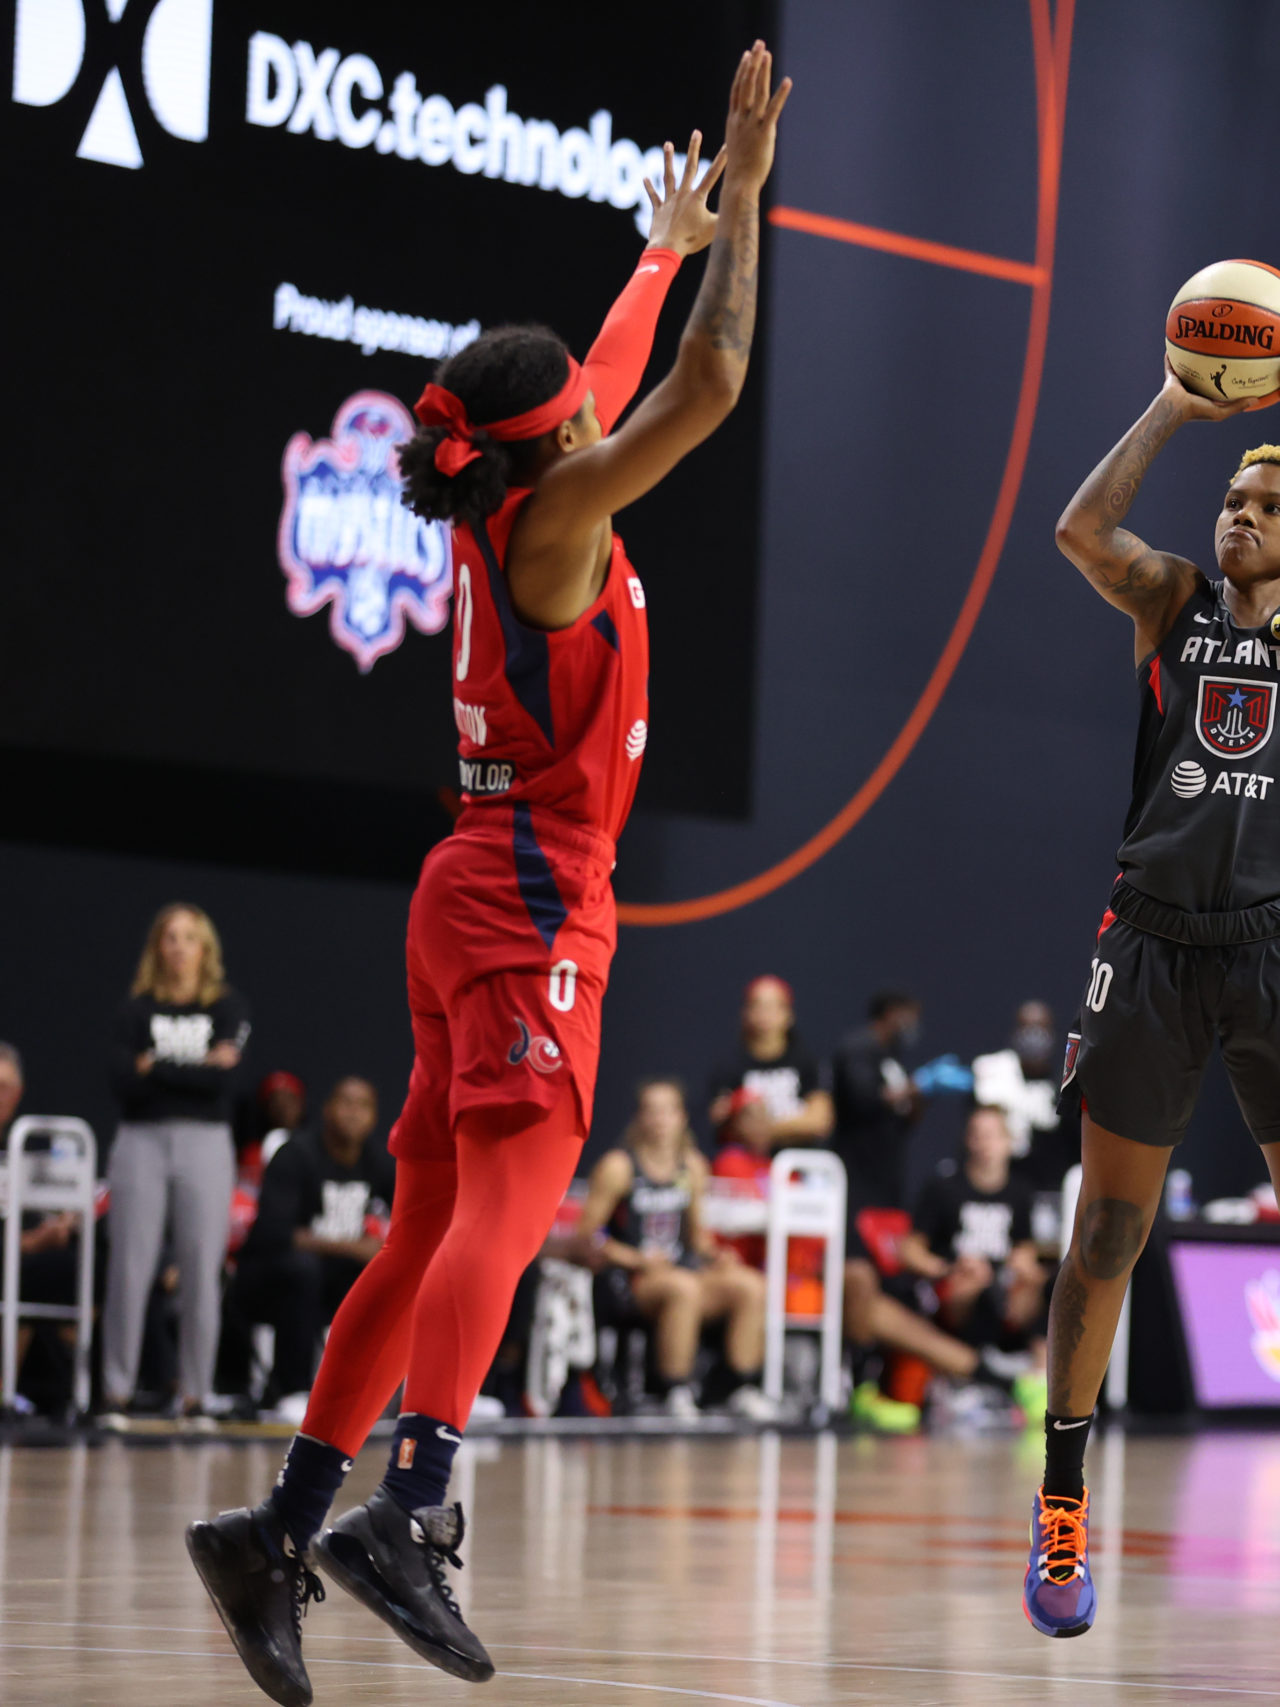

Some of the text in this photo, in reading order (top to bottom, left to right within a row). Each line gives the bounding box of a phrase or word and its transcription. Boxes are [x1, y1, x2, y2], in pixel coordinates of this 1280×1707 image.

[245, 30, 717, 240] DXC.technolog
[1175, 314, 1275, 350] SPALDING
[1210, 727, 1256, 747] DREAM
[1211, 771, 1275, 800] AT&T
[549, 959, 578, 1012] 0
[1086, 957, 1114, 1013] 10
